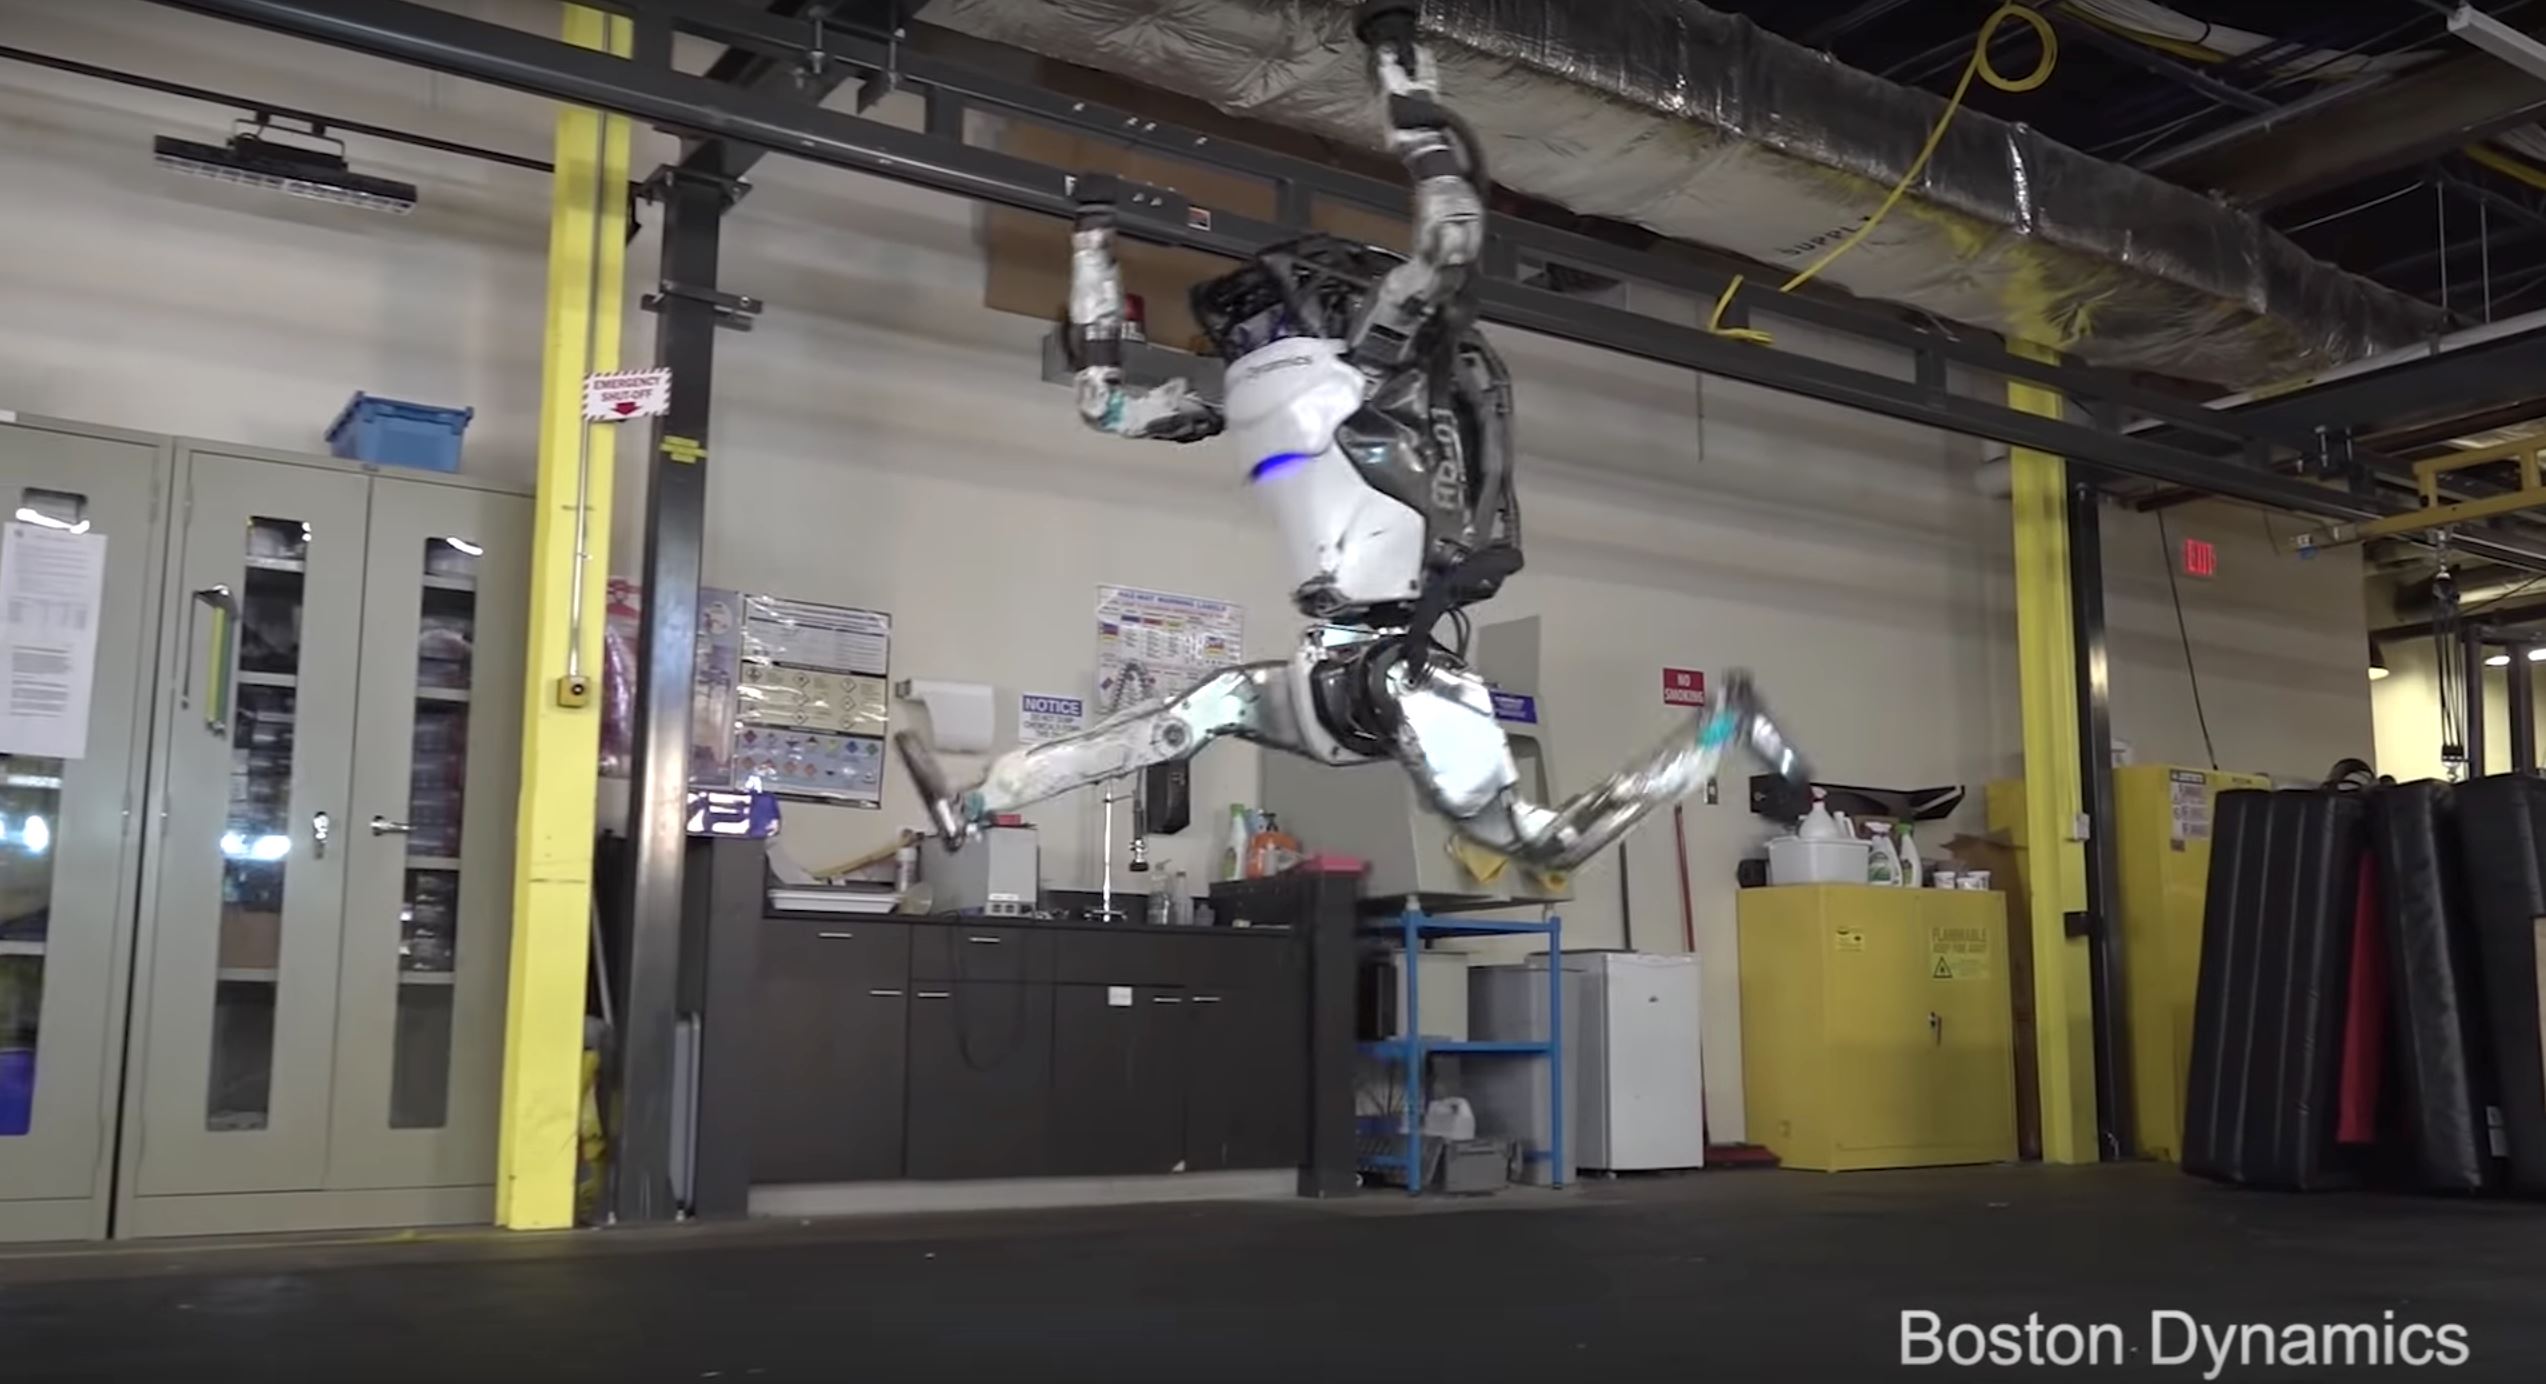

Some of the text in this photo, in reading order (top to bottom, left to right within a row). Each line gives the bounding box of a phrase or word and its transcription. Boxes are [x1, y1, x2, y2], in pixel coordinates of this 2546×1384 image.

[593, 377, 660, 390] EMERGENCY
[1677, 673, 1691, 687] NO
[1664, 688, 1704, 703] SMOKING
[1025, 697, 1080, 715] NOTICE
